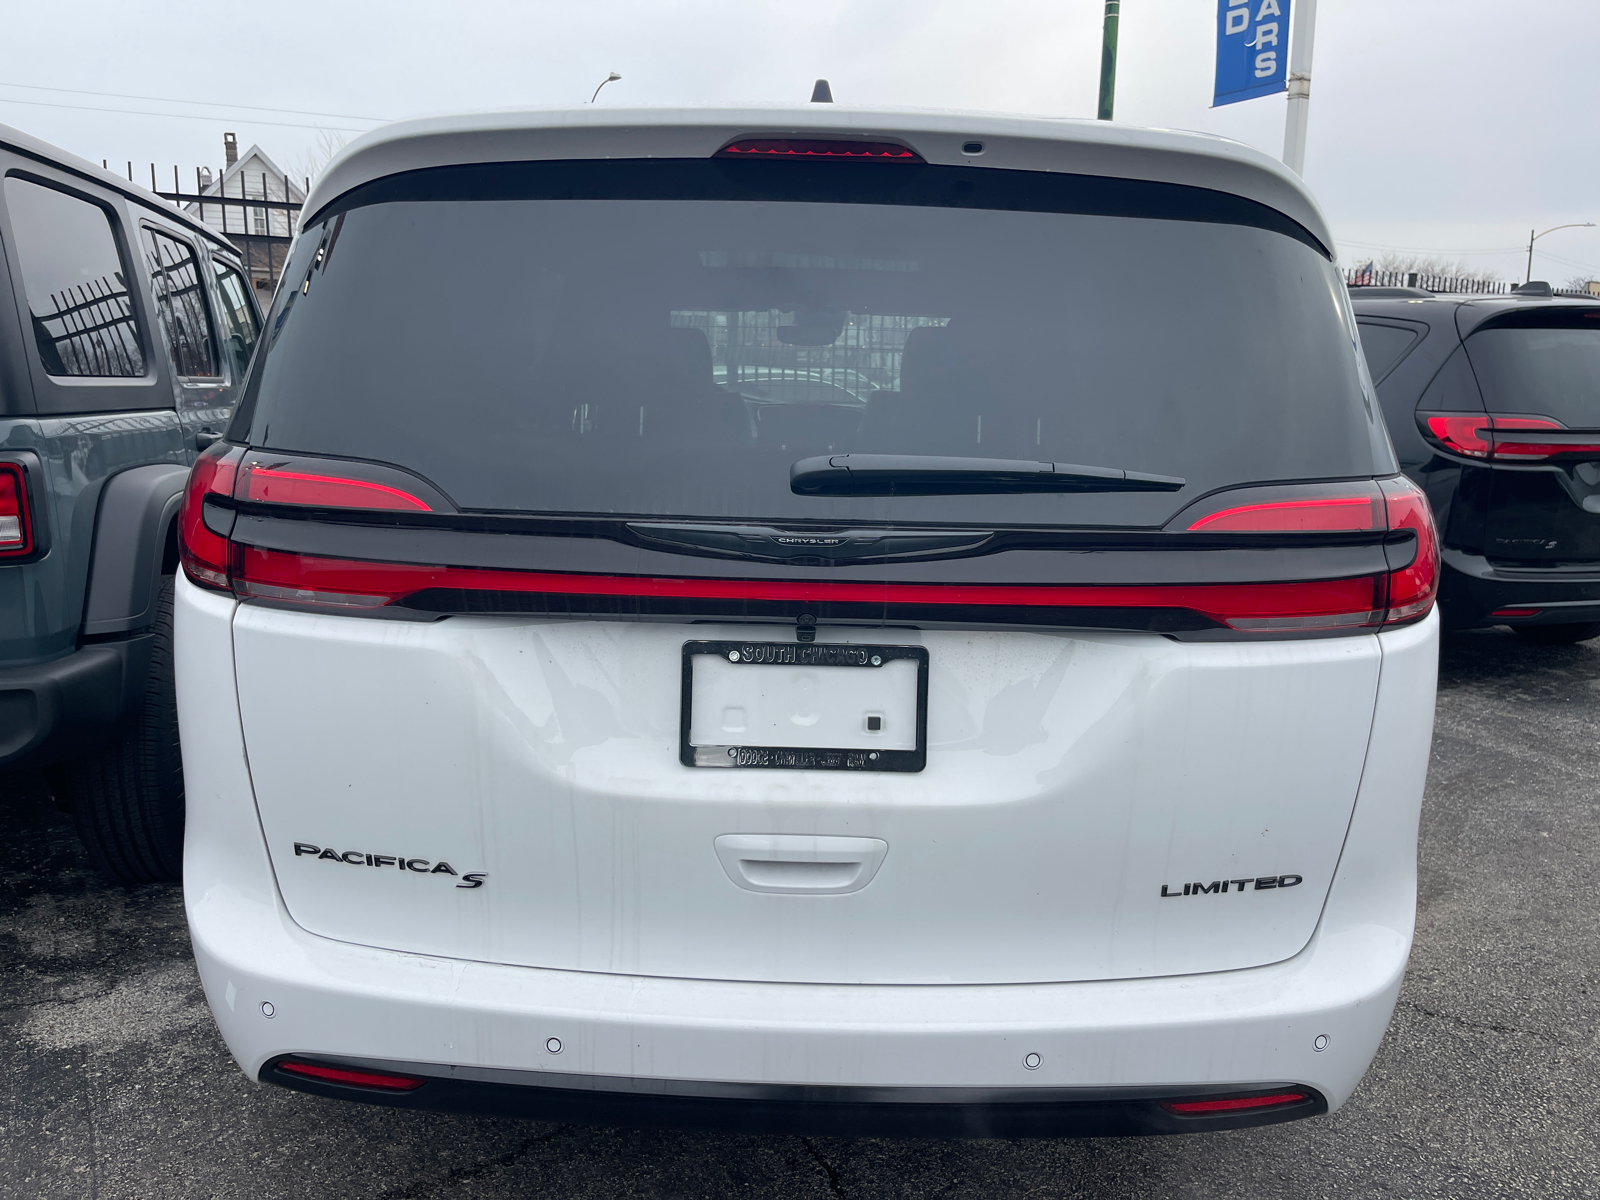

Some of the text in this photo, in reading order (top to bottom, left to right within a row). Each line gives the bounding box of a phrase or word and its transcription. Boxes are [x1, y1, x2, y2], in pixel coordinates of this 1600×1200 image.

[741, 644, 869, 665] SOUTH CHICAGO
[293, 841, 489, 889] PACIFICA S
[1160, 874, 1303, 898] LIMITED
